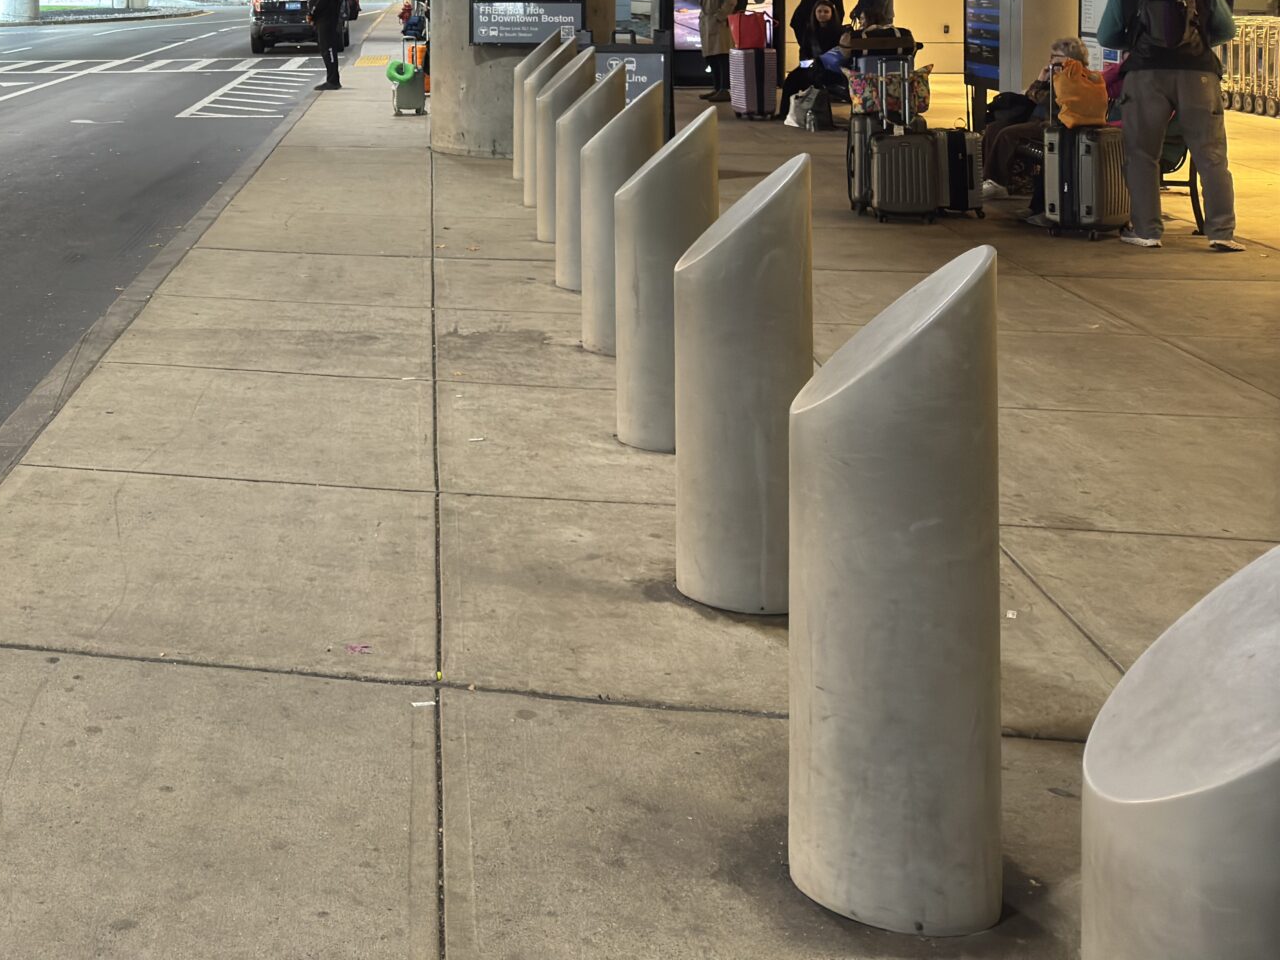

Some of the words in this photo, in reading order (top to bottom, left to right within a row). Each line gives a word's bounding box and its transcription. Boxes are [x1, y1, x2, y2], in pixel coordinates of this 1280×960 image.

[479, 6, 505, 15] FREE
[526, 6, 545, 15] ride
[627, 73, 648, 83] Line
